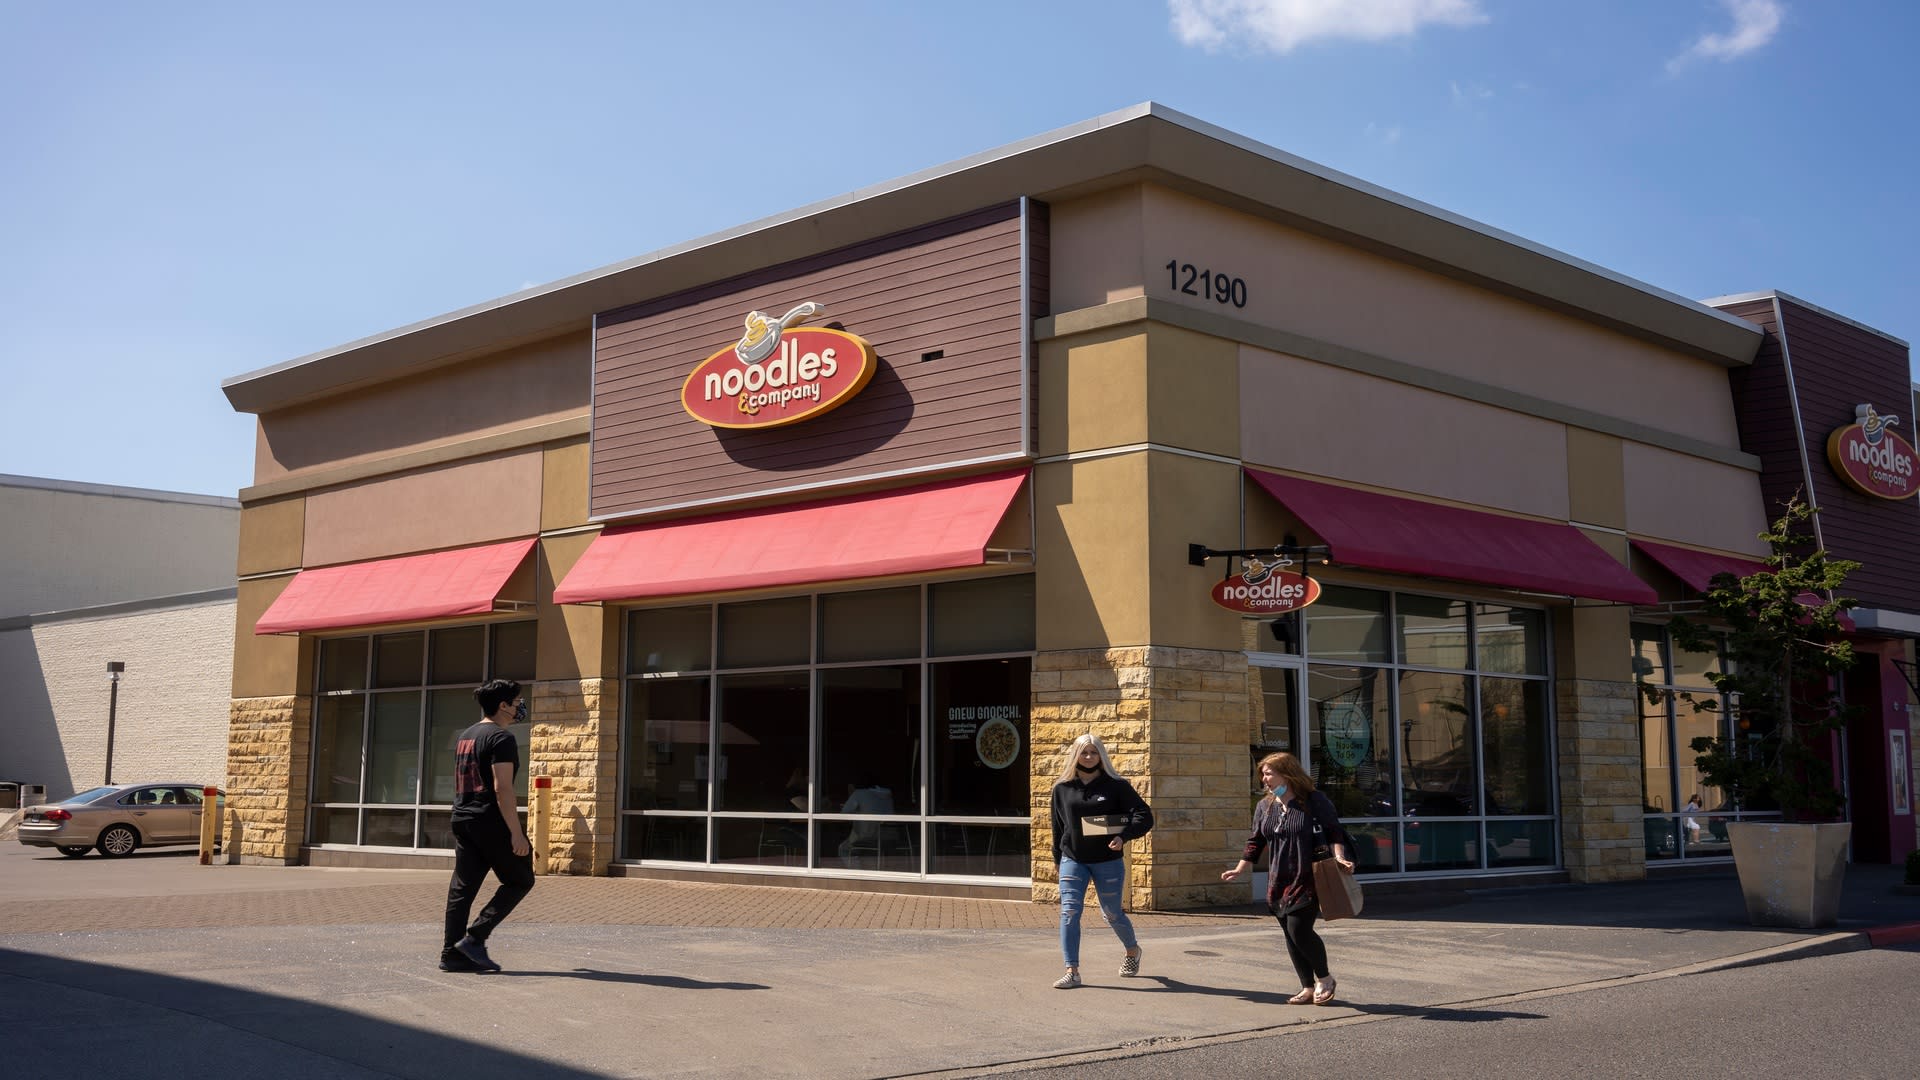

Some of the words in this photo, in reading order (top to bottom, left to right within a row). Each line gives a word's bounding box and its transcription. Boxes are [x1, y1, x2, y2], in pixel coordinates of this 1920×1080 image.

[1166, 260, 1247, 308] 12190
[705, 338, 838, 400] noodles
[1849, 436, 1913, 476] noodles
[1223, 576, 1304, 600] noodles
[948, 707, 976, 720] GNEW
